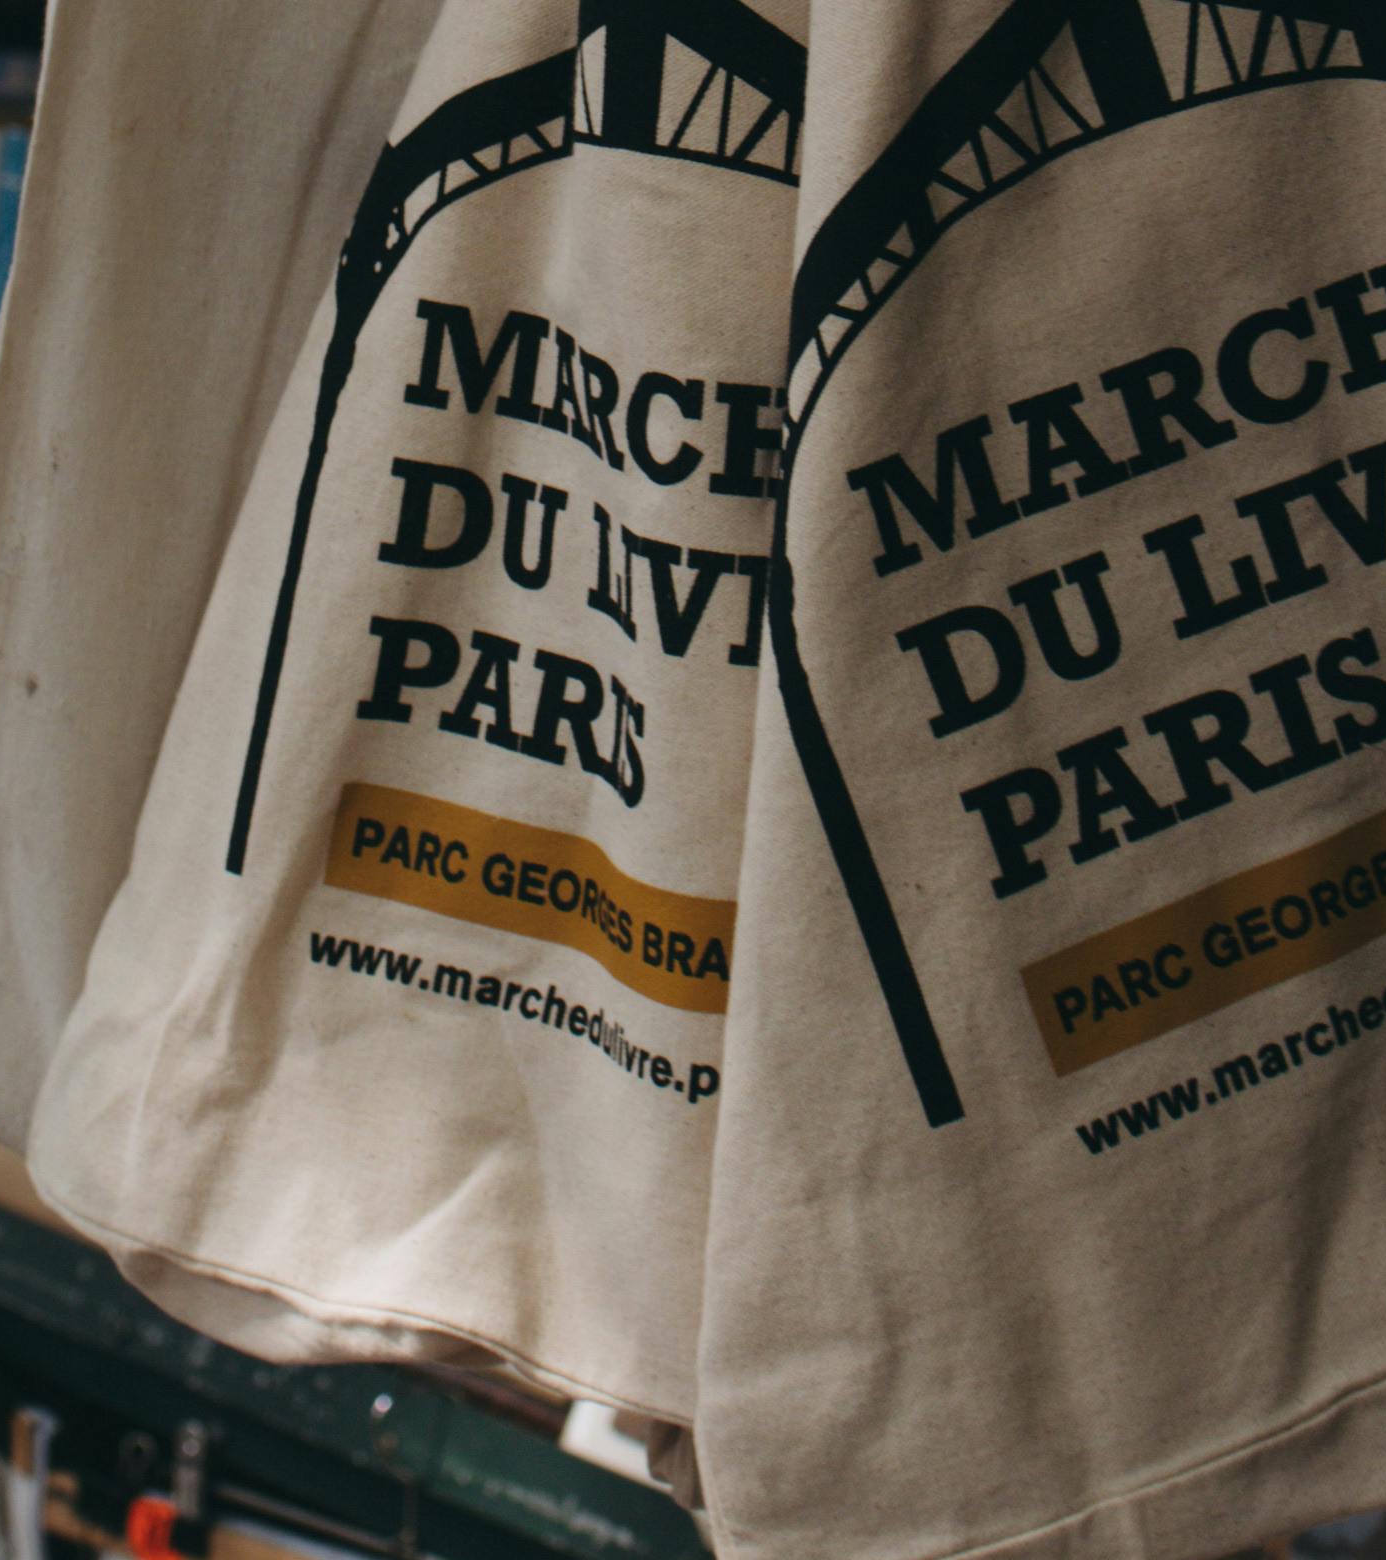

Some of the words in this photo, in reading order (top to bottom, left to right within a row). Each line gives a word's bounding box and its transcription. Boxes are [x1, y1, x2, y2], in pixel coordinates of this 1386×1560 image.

[378, 457, 569, 590] DU
[895, 549, 1122, 739] DU
[351, 817, 468, 883] PARC
[481, 853, 633, 953] GEORGES
[642, 921, 730, 982] BRA
[1052, 943, 1193, 1033] PARC
